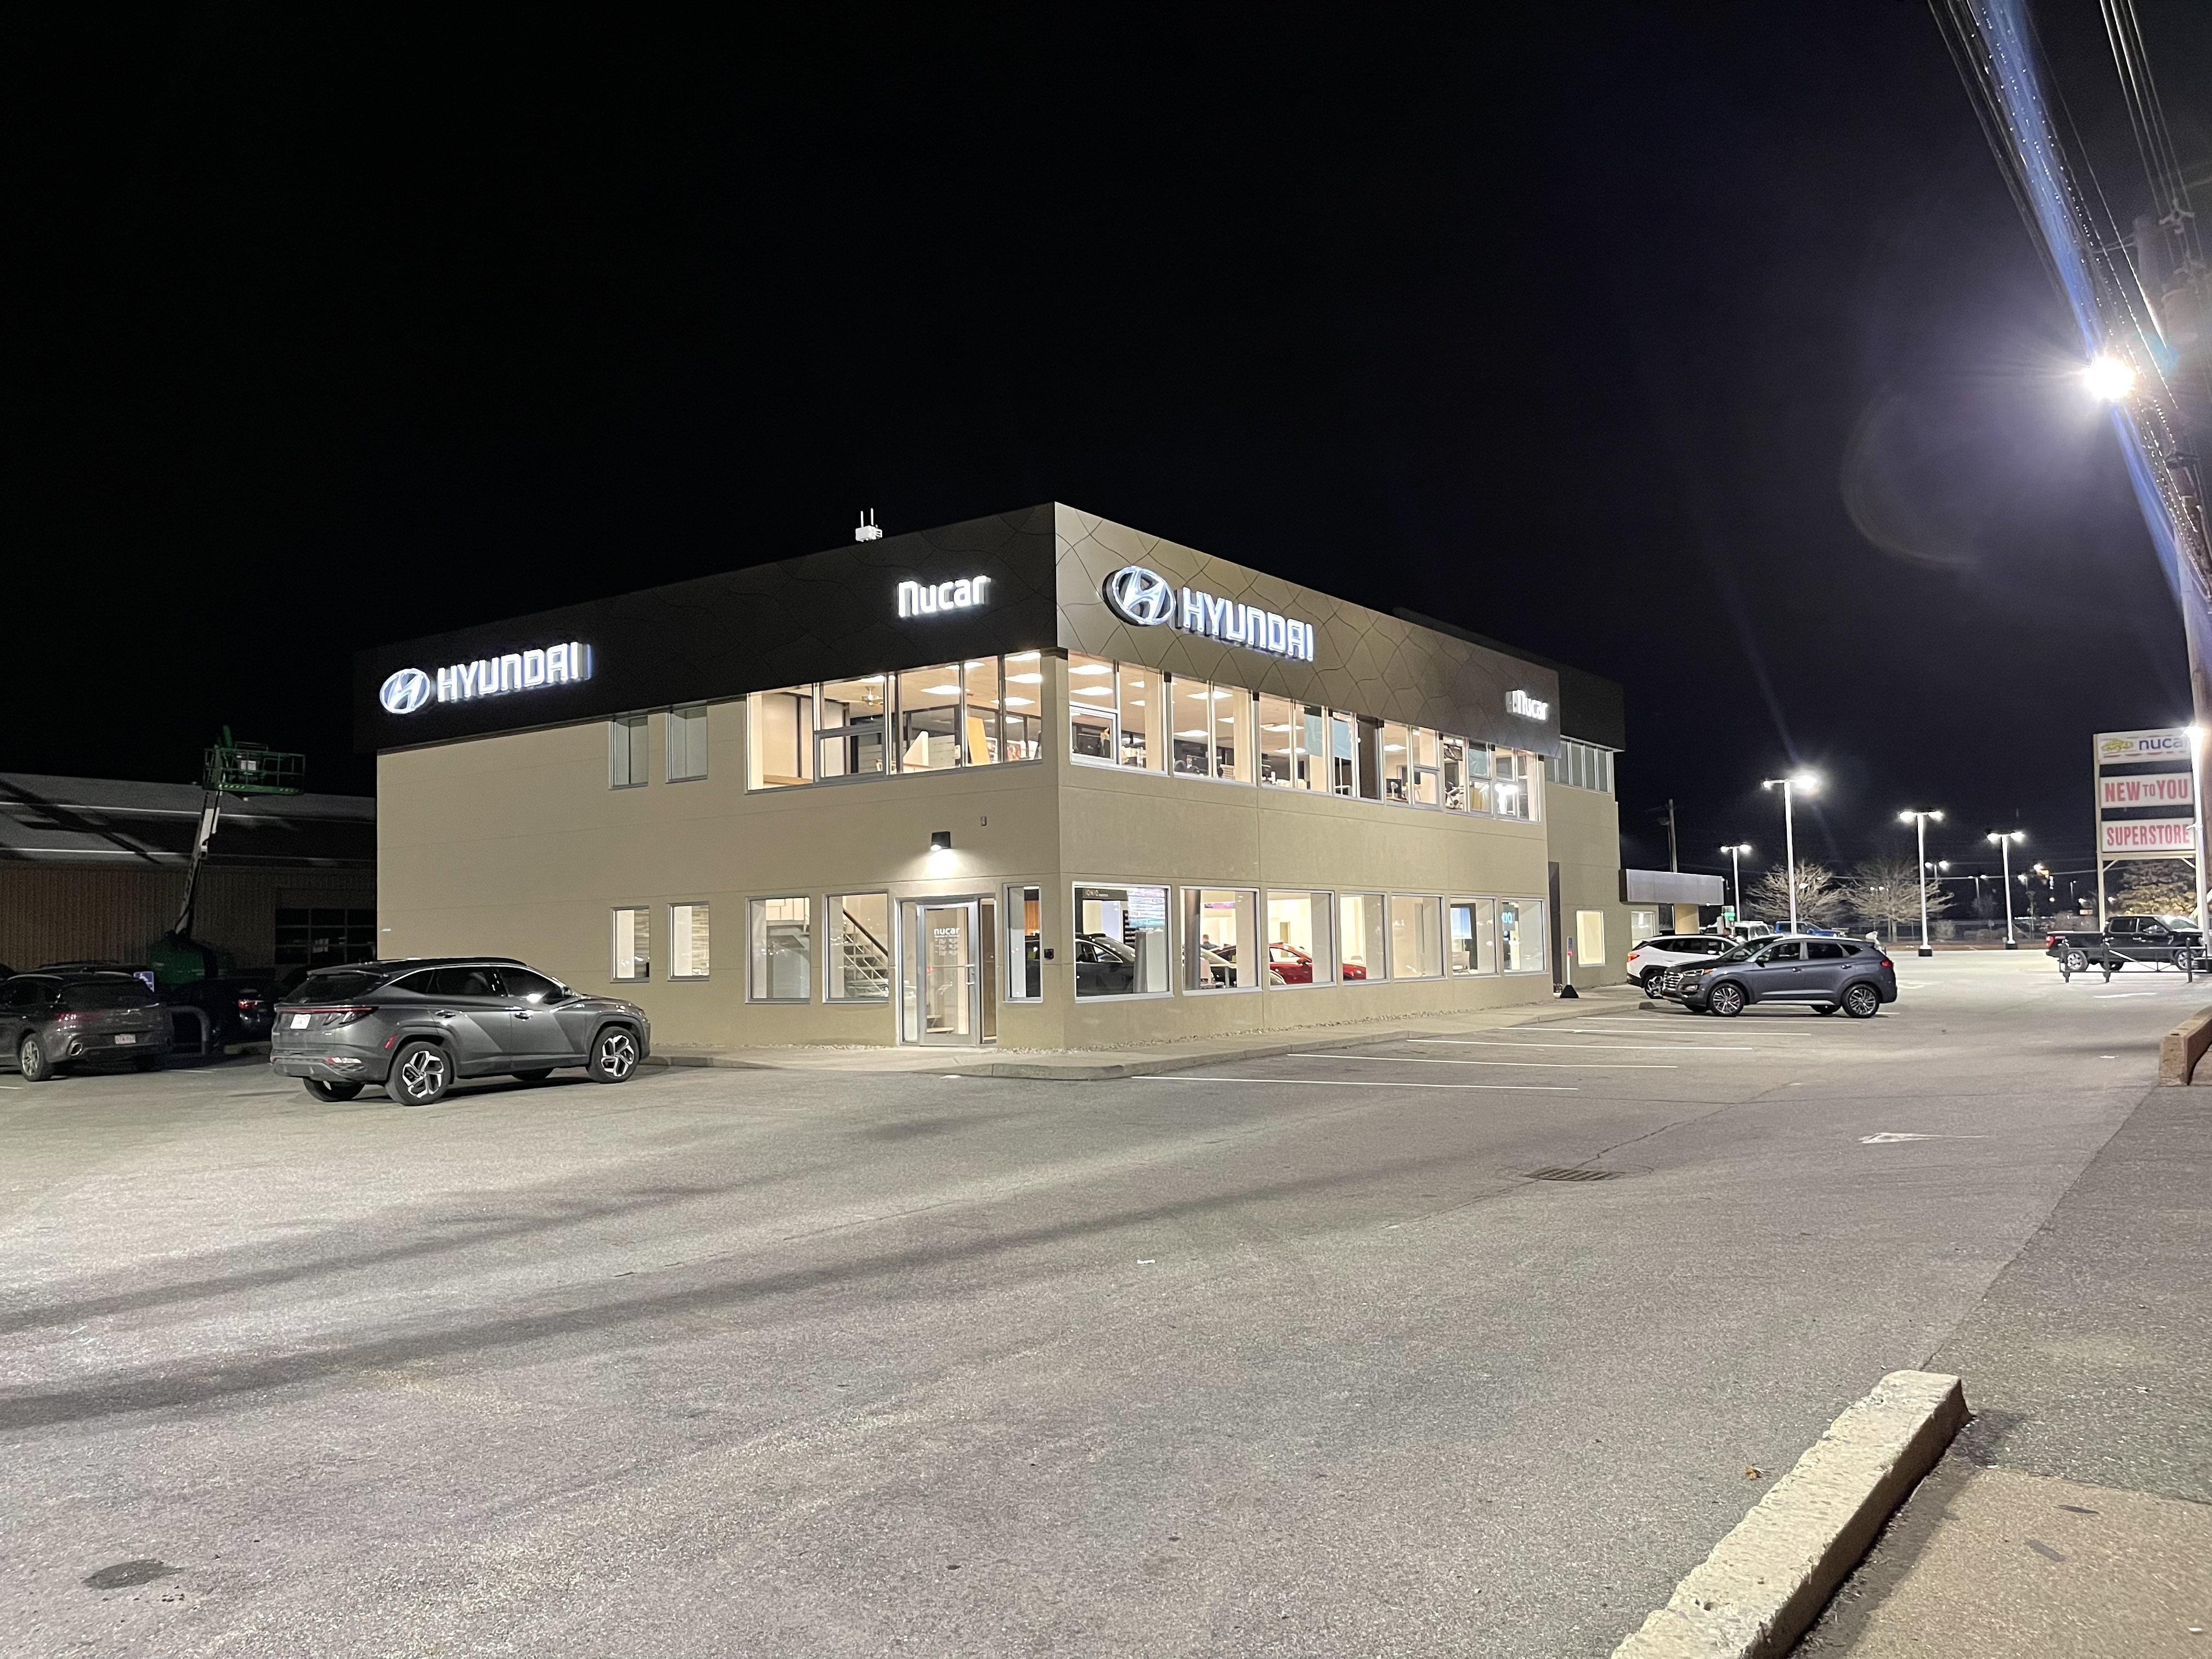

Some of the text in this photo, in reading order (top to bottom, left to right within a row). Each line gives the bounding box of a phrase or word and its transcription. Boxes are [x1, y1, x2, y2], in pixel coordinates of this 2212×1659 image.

[1182, 586, 1313, 662] HYUNDAI
[437, 641, 580, 703] HYUNDAI
[2138, 738, 2186, 751] nuca
[2104, 778, 2188, 802] NEW TO YOU
[2106, 824, 2190, 847] SUPERSTORE
